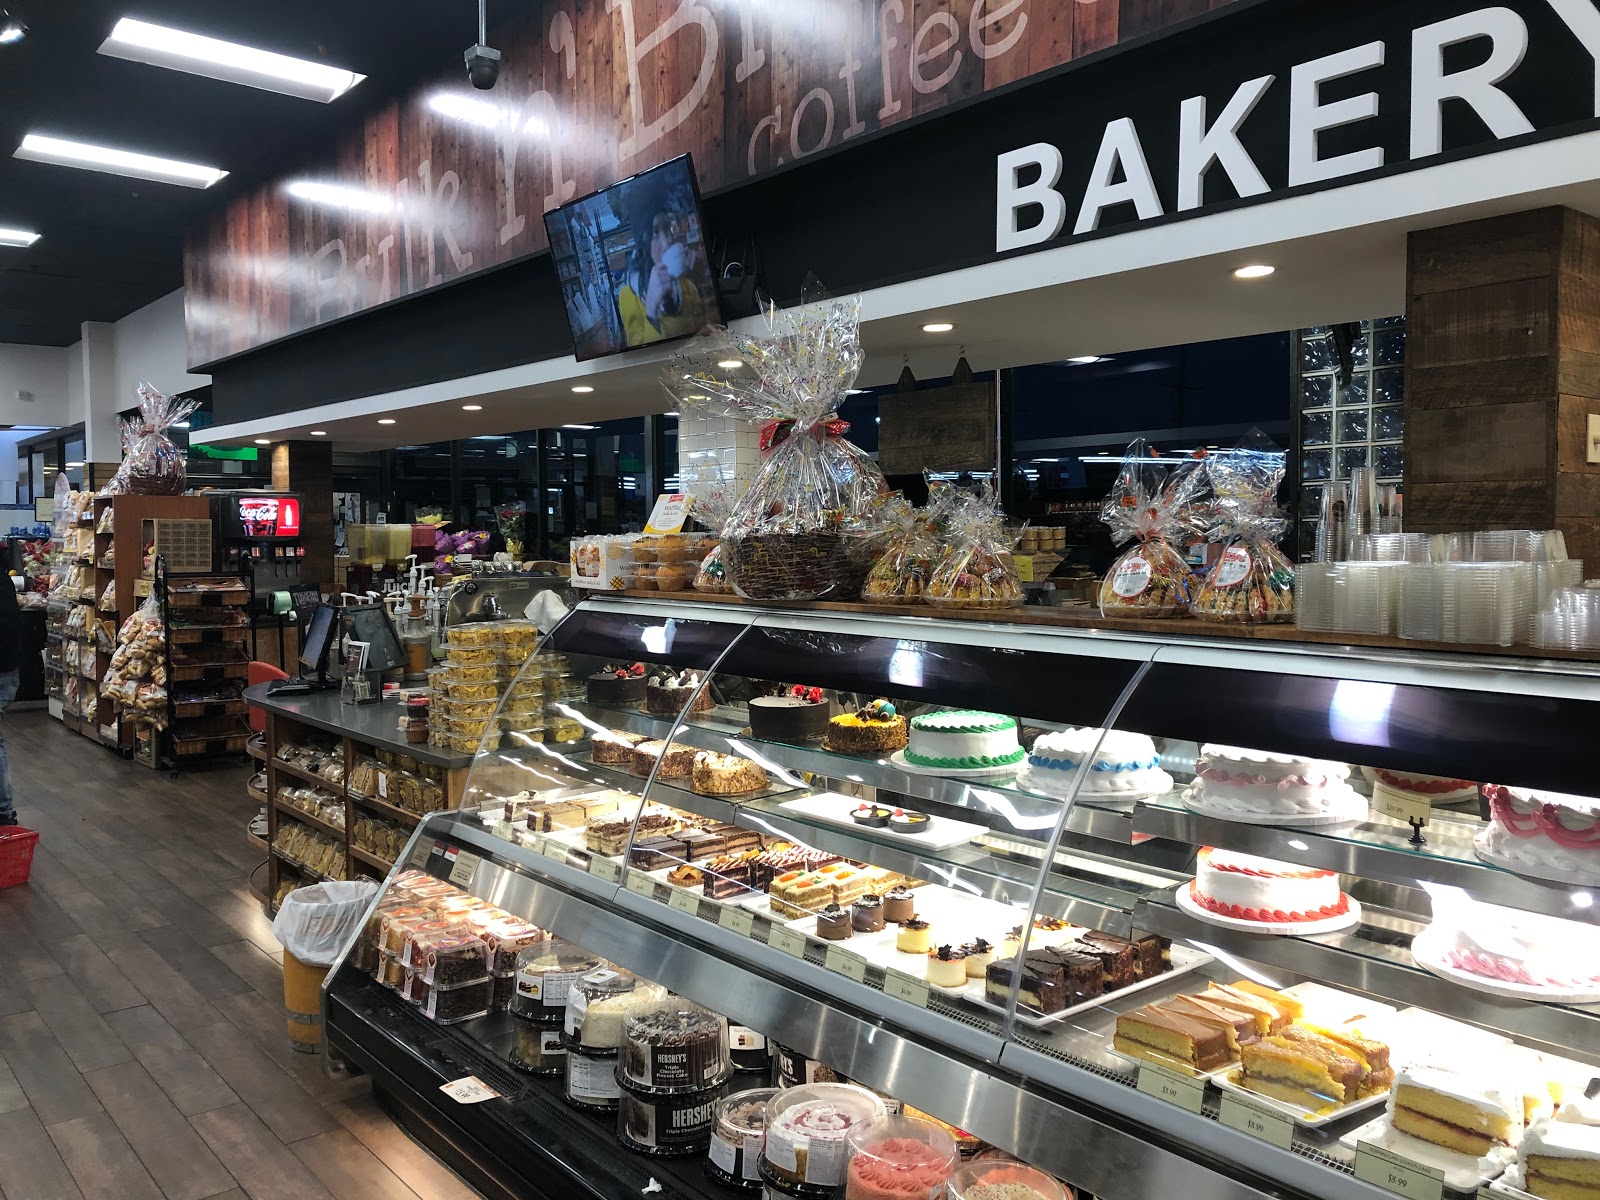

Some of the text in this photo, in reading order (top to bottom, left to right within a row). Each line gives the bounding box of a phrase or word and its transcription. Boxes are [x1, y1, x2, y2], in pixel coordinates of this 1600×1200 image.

[381, 582, 412, 594] JUIC
[657, 1053, 687, 1063] HERSHEY'S
[672, 1097, 720, 1128] HERSHEY
[1247, 1120, 1265, 1132] $3.99
[1387, 1173, 1407, 1188] $3.99
